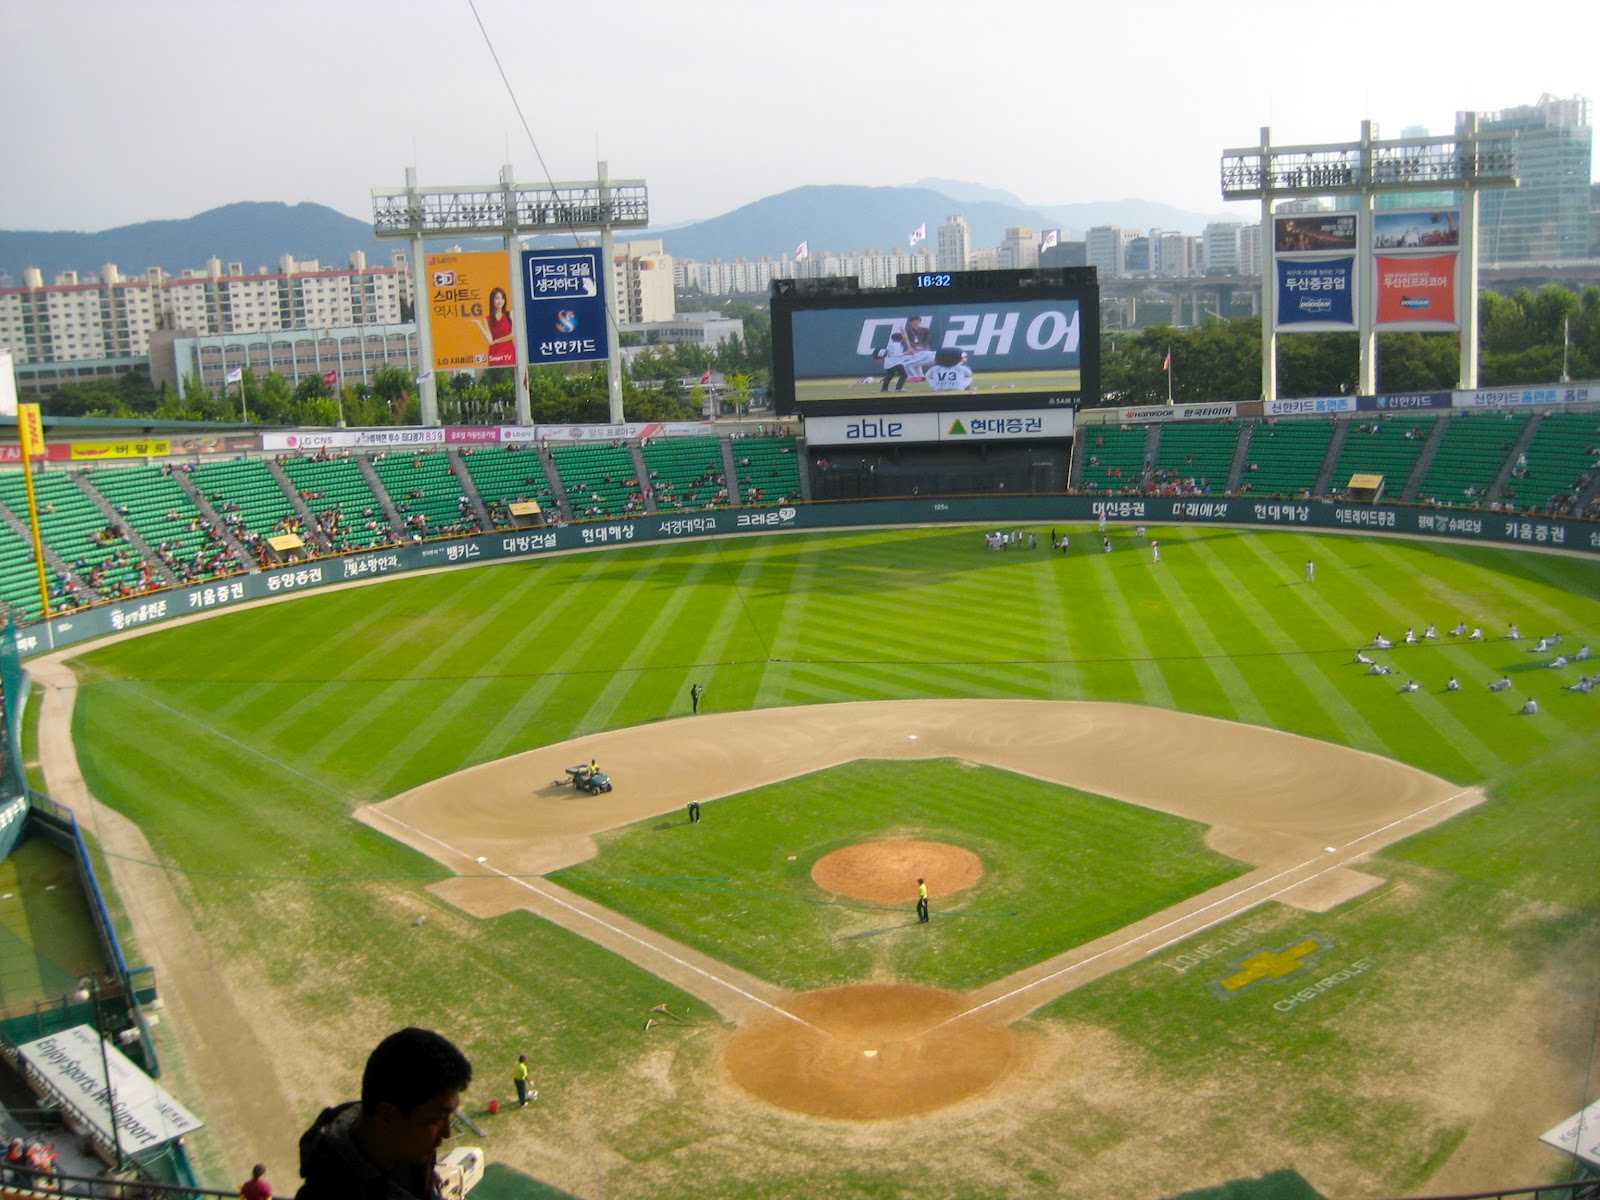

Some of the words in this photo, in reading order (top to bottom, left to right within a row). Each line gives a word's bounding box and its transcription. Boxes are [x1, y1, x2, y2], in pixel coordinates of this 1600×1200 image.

[535, 263, 568, 278] 카드의
[570, 262, 590, 277] 길을
[536, 277, 580, 293] 생각하다
[916, 274, 951, 288] 16:32
[1285, 276, 1346, 292] 두산중공업
[1384, 276, 1447, 289] 두산인프라코어
[433, 288, 482, 302] 스마트도
[434, 304, 458, 318] 역시
[461, 303, 483, 317] LG
[540, 339, 597, 356] 신한카드
[937, 371, 957, 382] V3
[1272, 400, 1314, 414] 신한카드
[1388, 396, 1432, 409] 신한카드
[1184, 406, 1233, 418] 한국타이어
[607, 427, 636, 437] 프로야구
[846, 418, 903, 439] able
[970, 417, 1043, 436] 현대증권
[301, 437, 312, 446] LG
[314, 436, 333, 445] CNS
[425, 431, 443, 441] 839
[1092, 502, 1145, 517] 대신증권
[1172, 503, 1228, 518] 미래에셋
[1254, 504, 1310, 522] 현대해상
[1335, 509, 1396, 526] 이트레이드증권
[658, 517, 717, 535] 서경대학교
[737, 512, 780, 527] 크레온
[581, 524, 635, 544] 현대해상
[1505, 522, 1565, 543] 키움증권
[503, 532, 557, 553] 대방건설
[446, 543, 481, 561] 뱅키스
[267, 567, 323, 591] 동양증권
[189, 581, 244, 608] 키움증권
[1273, 956, 1378, 1013] CHEVROLET
[36, 1038, 69, 1065] Enjoy
